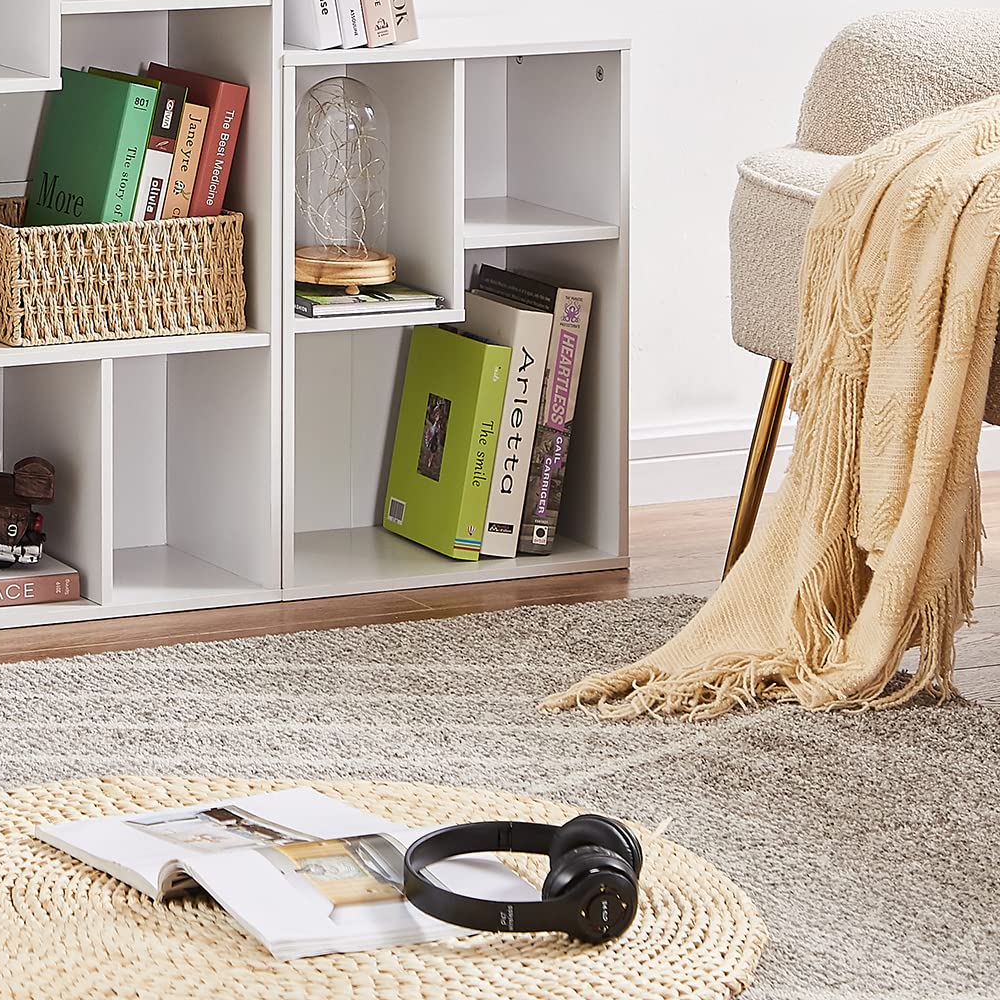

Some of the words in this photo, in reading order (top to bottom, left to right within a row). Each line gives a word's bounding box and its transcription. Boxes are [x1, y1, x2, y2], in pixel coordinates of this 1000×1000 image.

[134, 96, 150, 108] 801
[185, 113, 202, 148] Jane
[222, 109, 236, 131] The
[123, 146, 138, 168] The
[216, 132, 230, 157] Best
[36, 171, 84, 218] More
[115, 171, 129, 201] story
[146, 179, 161, 214] olivia
[205, 159, 225, 207] Medicine
[113, 203, 123, 217] of
[549, 332, 577, 427] HEARTLESS
[477, 420, 495, 446] The
[500, 346, 535, 495] Arletta
[553, 436, 563, 464] GAIL
[471, 450, 488, 488] smile
[538, 457, 552, 514] CARRIGER
